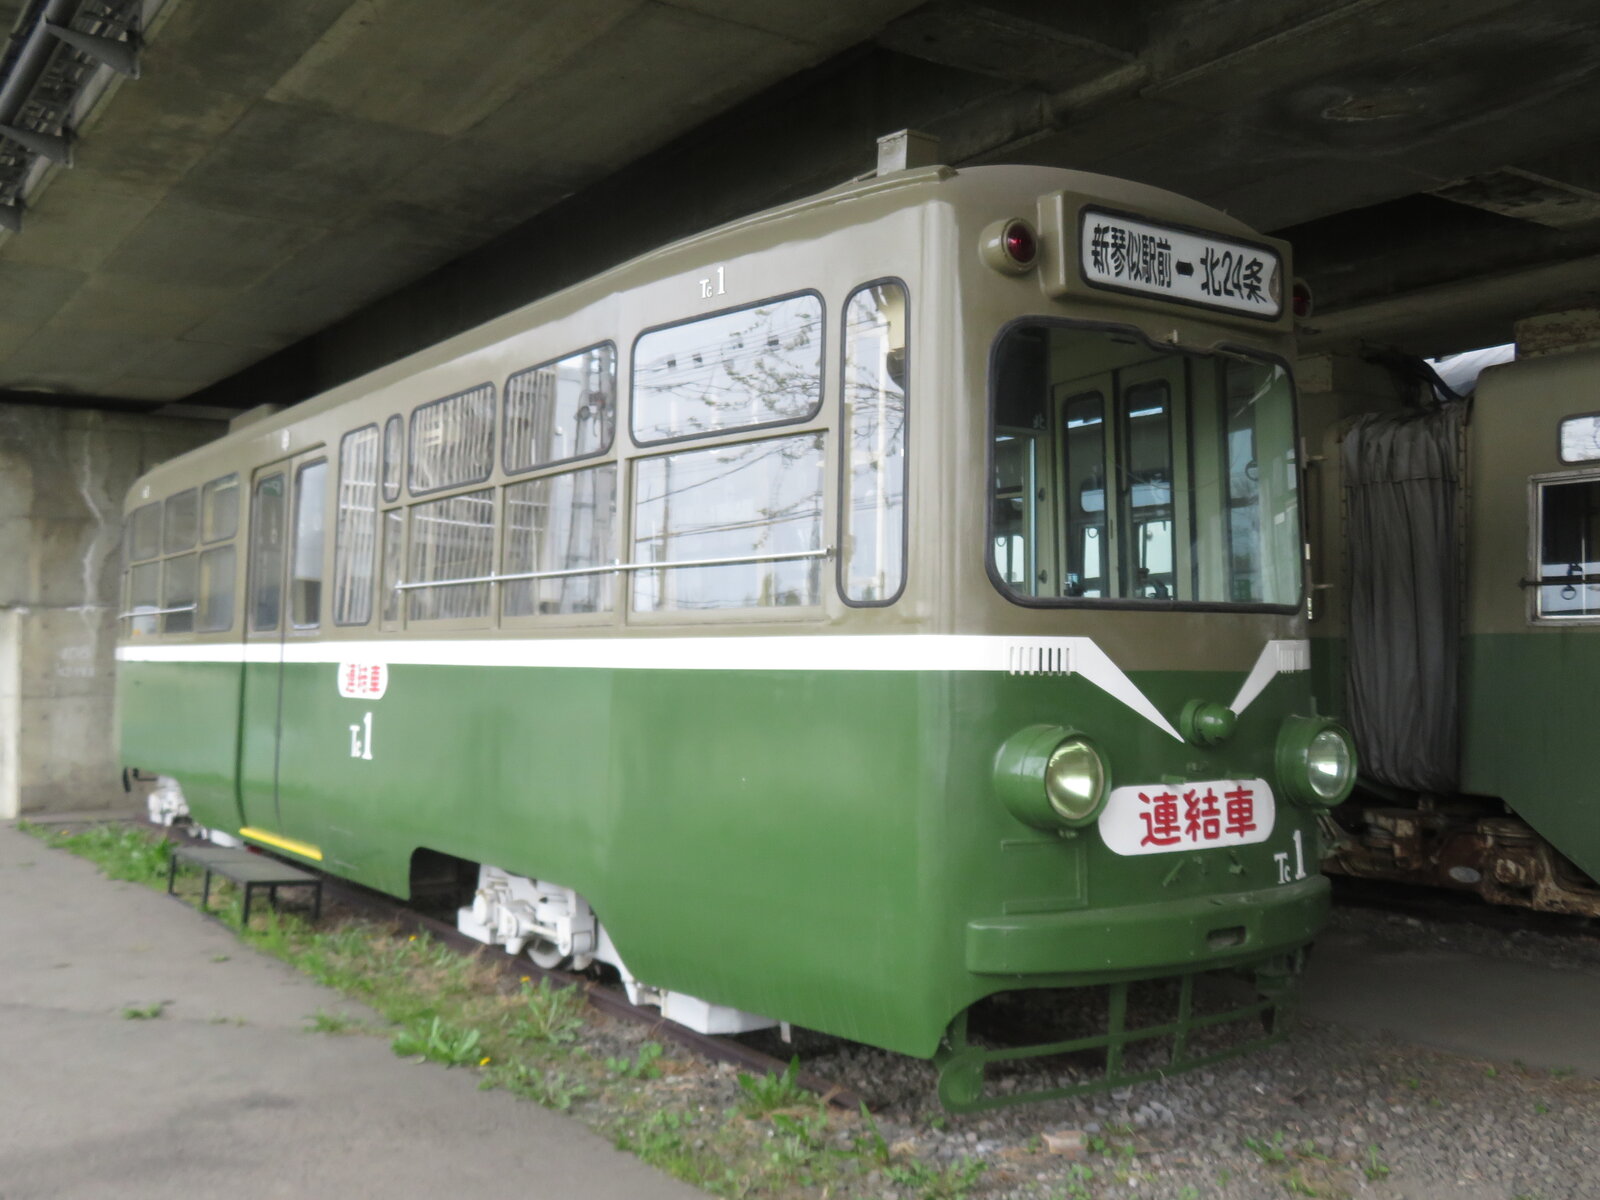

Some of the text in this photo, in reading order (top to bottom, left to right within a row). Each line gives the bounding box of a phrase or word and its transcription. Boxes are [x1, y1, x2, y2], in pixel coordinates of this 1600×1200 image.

[1091, 223, 1267, 304] 新琴似駅前 北24条
[1138, 785, 1257, 847] 連結車
